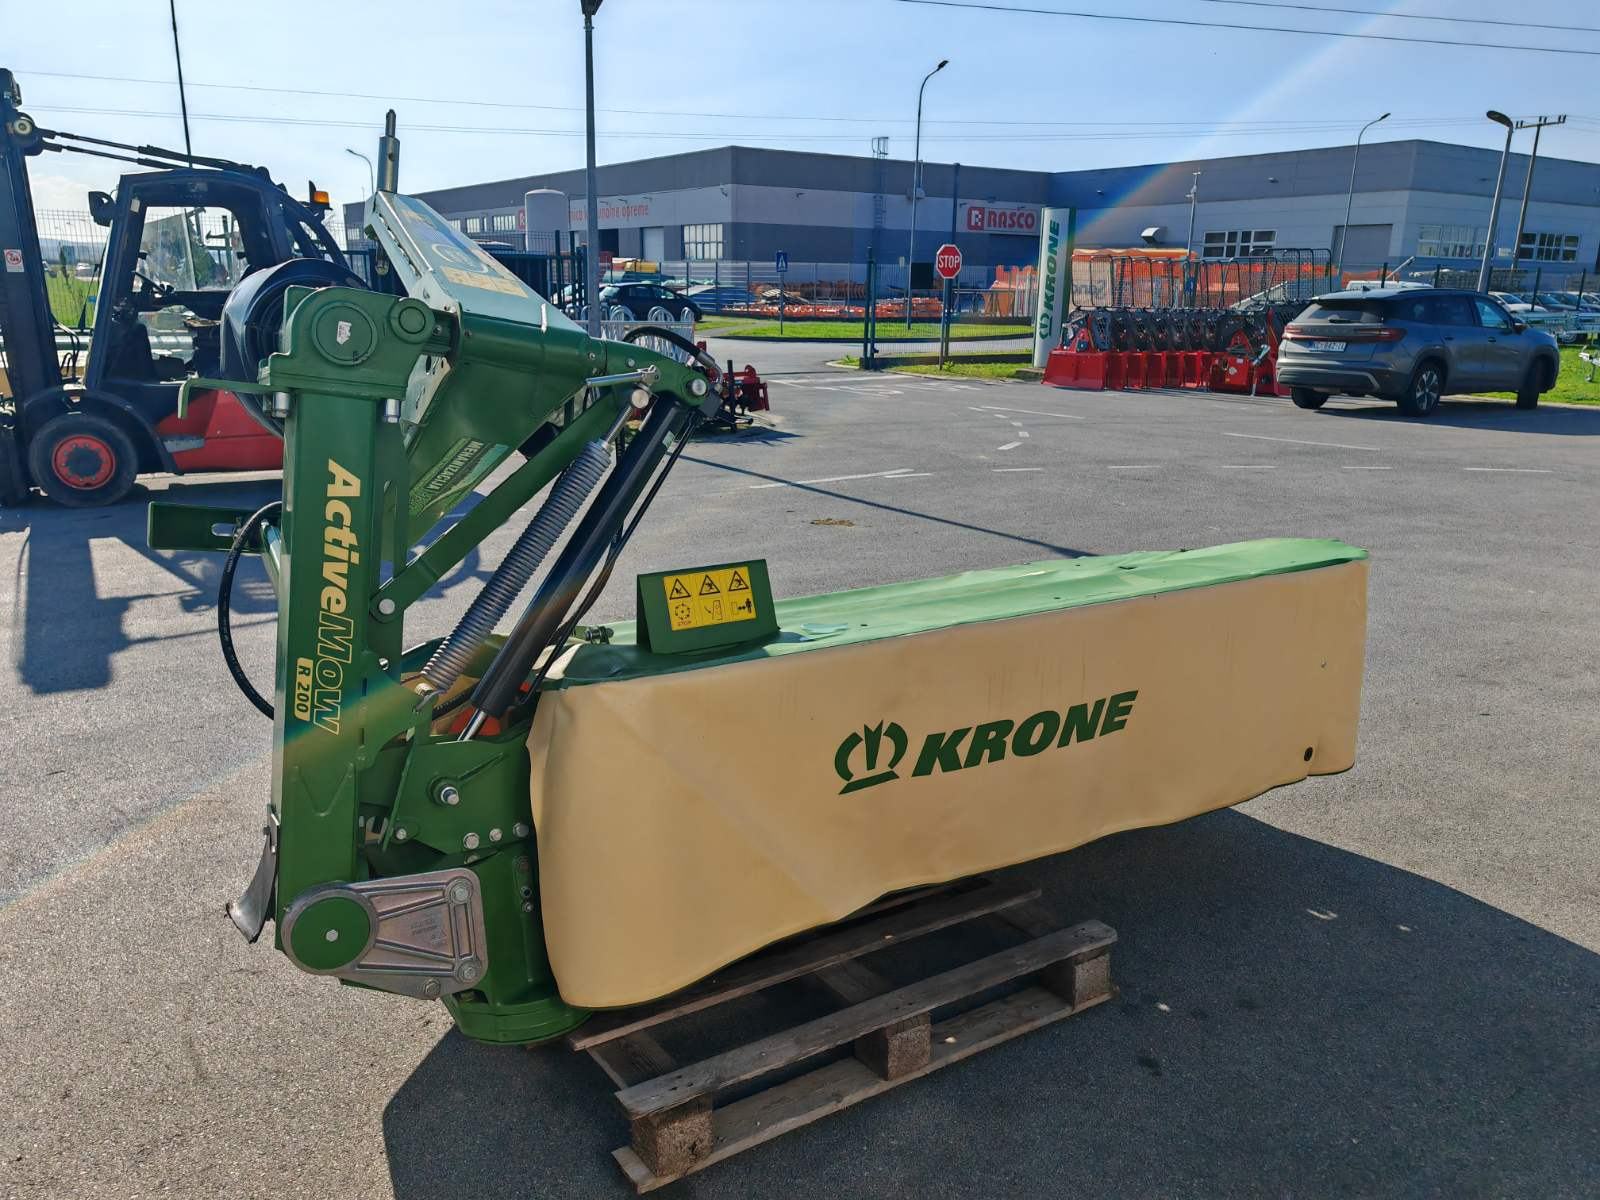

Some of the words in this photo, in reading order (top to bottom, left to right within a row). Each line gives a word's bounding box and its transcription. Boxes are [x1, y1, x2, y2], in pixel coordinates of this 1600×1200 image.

[988, 208, 1036, 229] RASCO
[938, 256, 961, 269] STOP
[1045, 219, 1060, 310] KRONE
[300, 665, 311, 675] R
[296, 677, 310, 714] 200
[911, 690, 1139, 777] KRONE
